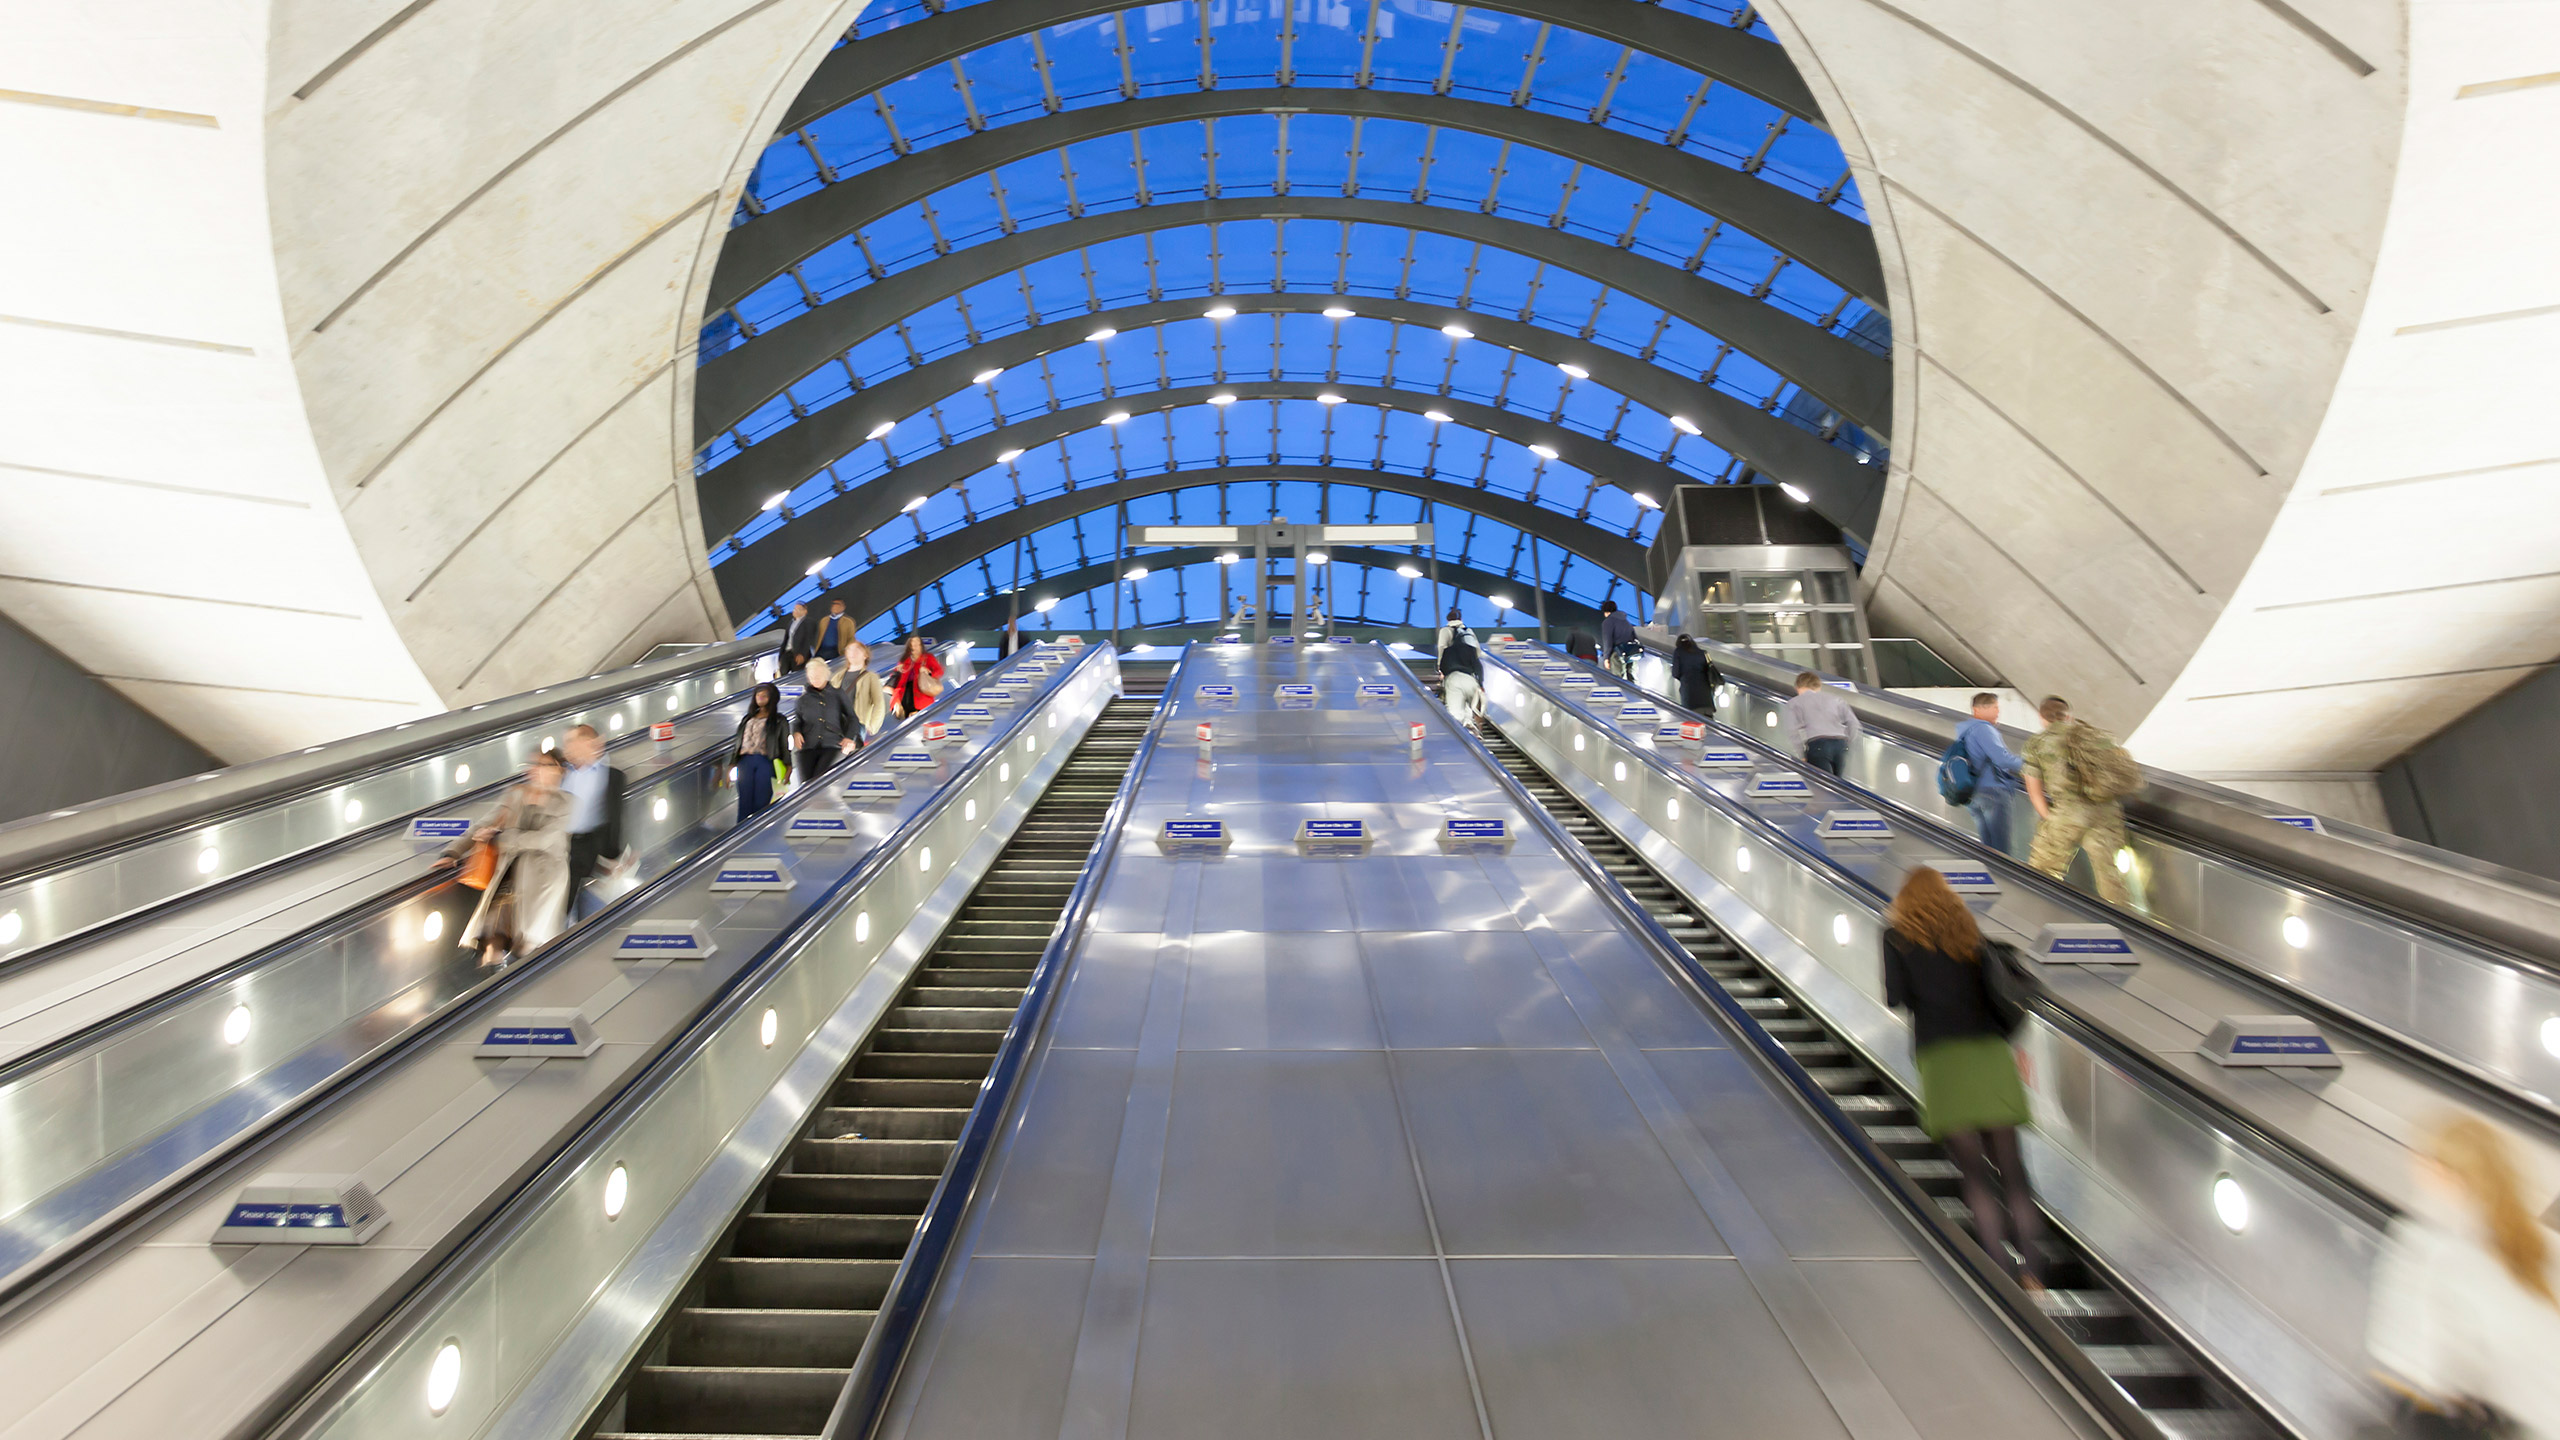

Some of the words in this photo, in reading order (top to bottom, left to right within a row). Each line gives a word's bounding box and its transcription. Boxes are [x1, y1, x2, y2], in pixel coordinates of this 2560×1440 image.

[240, 1209, 265, 1219] Please
[265, 1211, 288, 1220] stand
[288, 1212, 298, 1220] on
[299, 1211, 314, 1220] the
